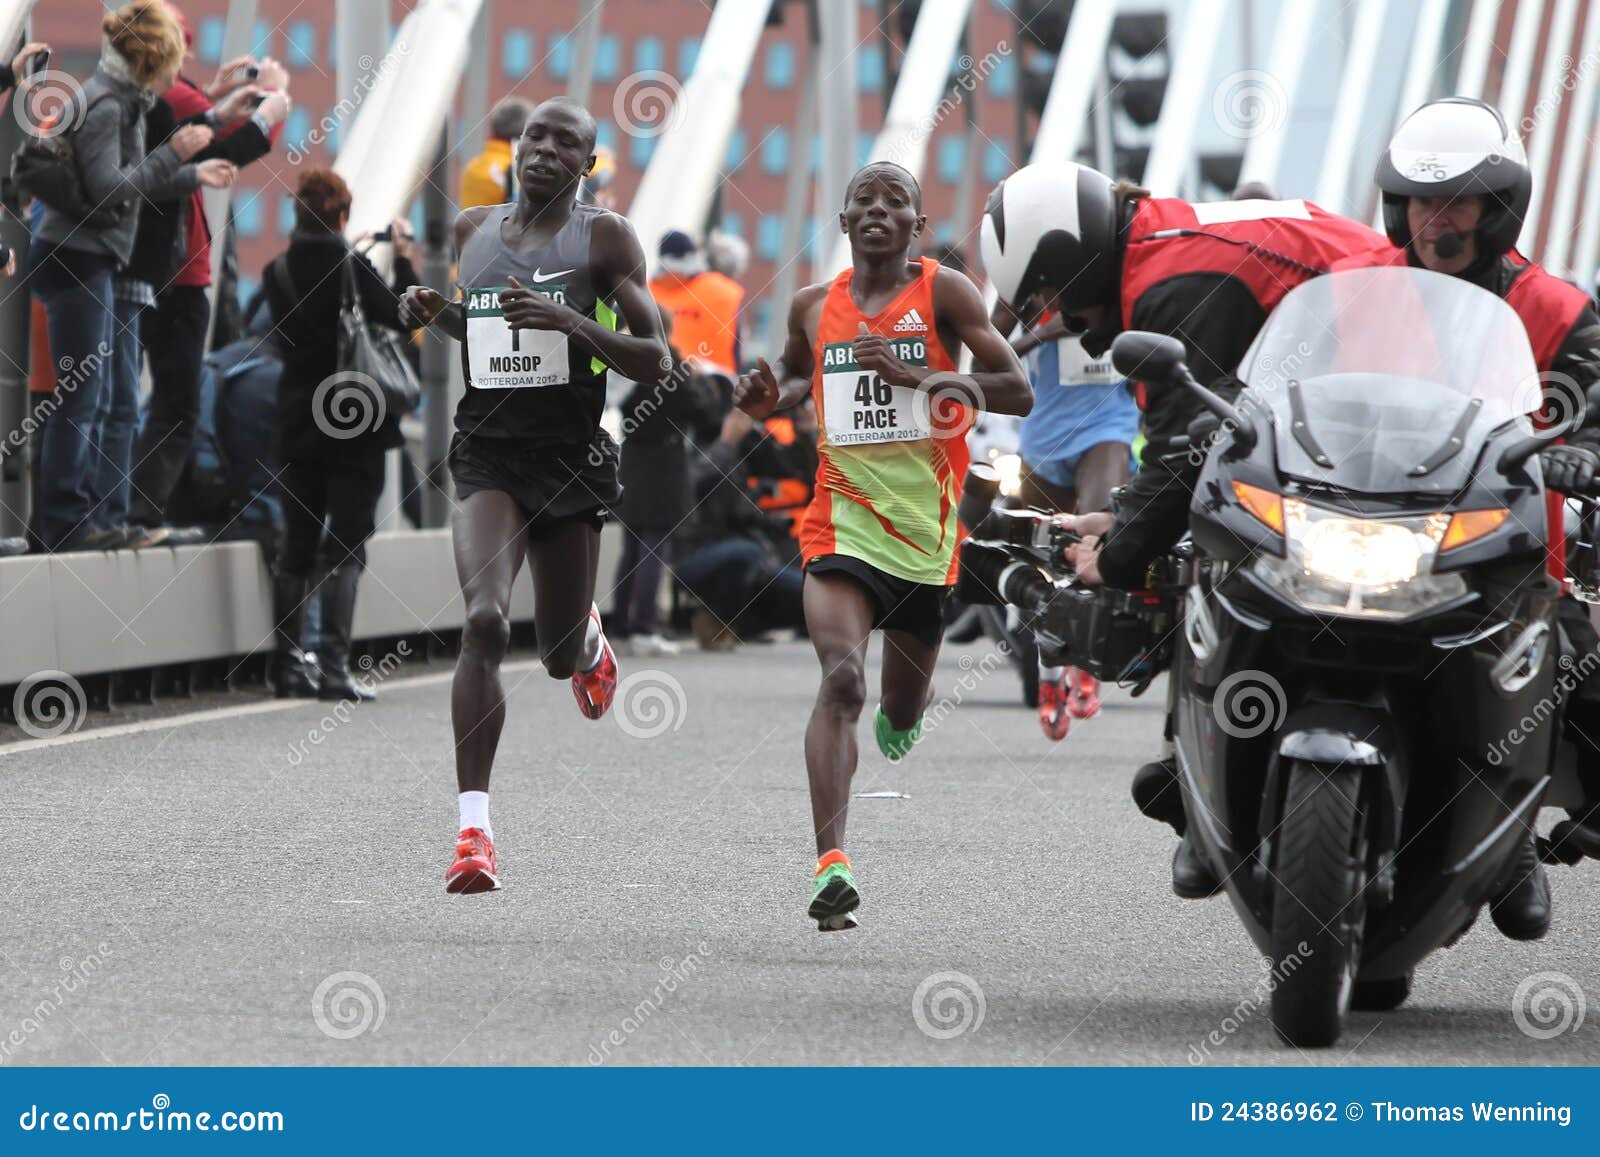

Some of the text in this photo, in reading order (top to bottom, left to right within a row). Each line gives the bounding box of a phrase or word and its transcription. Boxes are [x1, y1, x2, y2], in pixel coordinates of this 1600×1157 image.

[893, 323, 928, 332] adidas
[489, 355, 541, 373] MOSOP
[478, 375, 557, 386] ROTTERDAM 2012
[854, 375, 893, 406] 46
[854, 409, 897, 430] PACE
[834, 429, 919, 443] ROTTERDAM 2012
